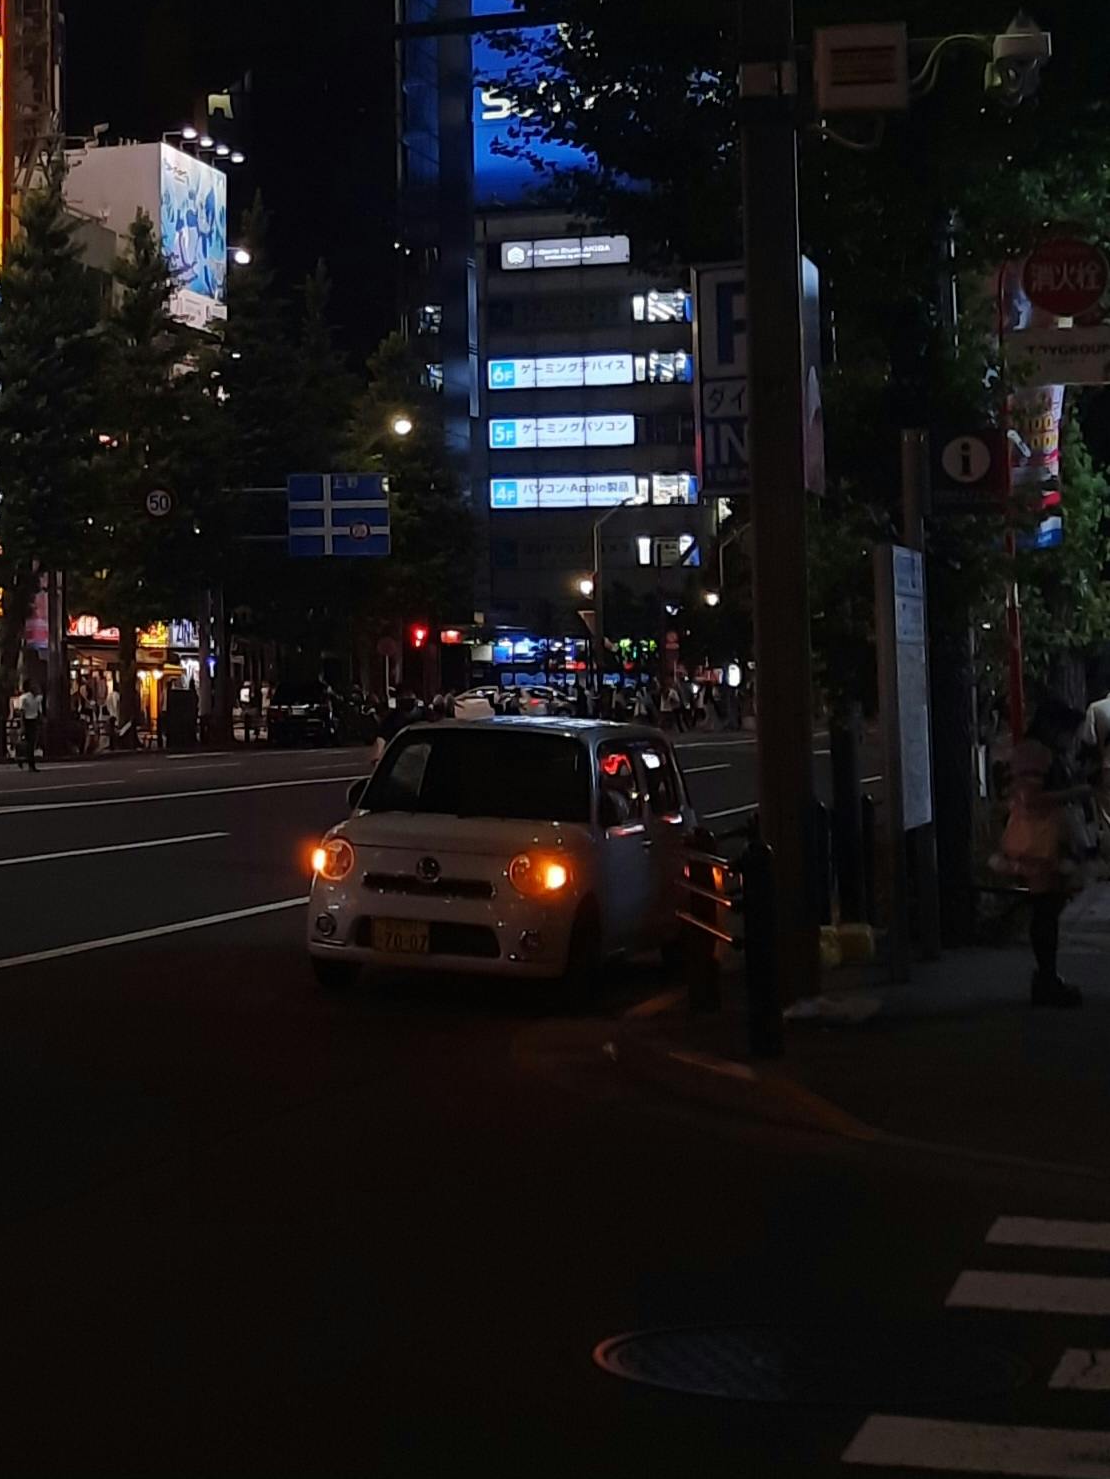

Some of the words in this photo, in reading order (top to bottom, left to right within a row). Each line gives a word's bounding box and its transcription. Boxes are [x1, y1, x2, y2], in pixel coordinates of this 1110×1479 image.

[1031, 261, 1103, 293] 消火栓
[494, 425, 514, 442] 5F
[496, 485, 516, 502] 4F
[149, 495, 169, 511] 50
